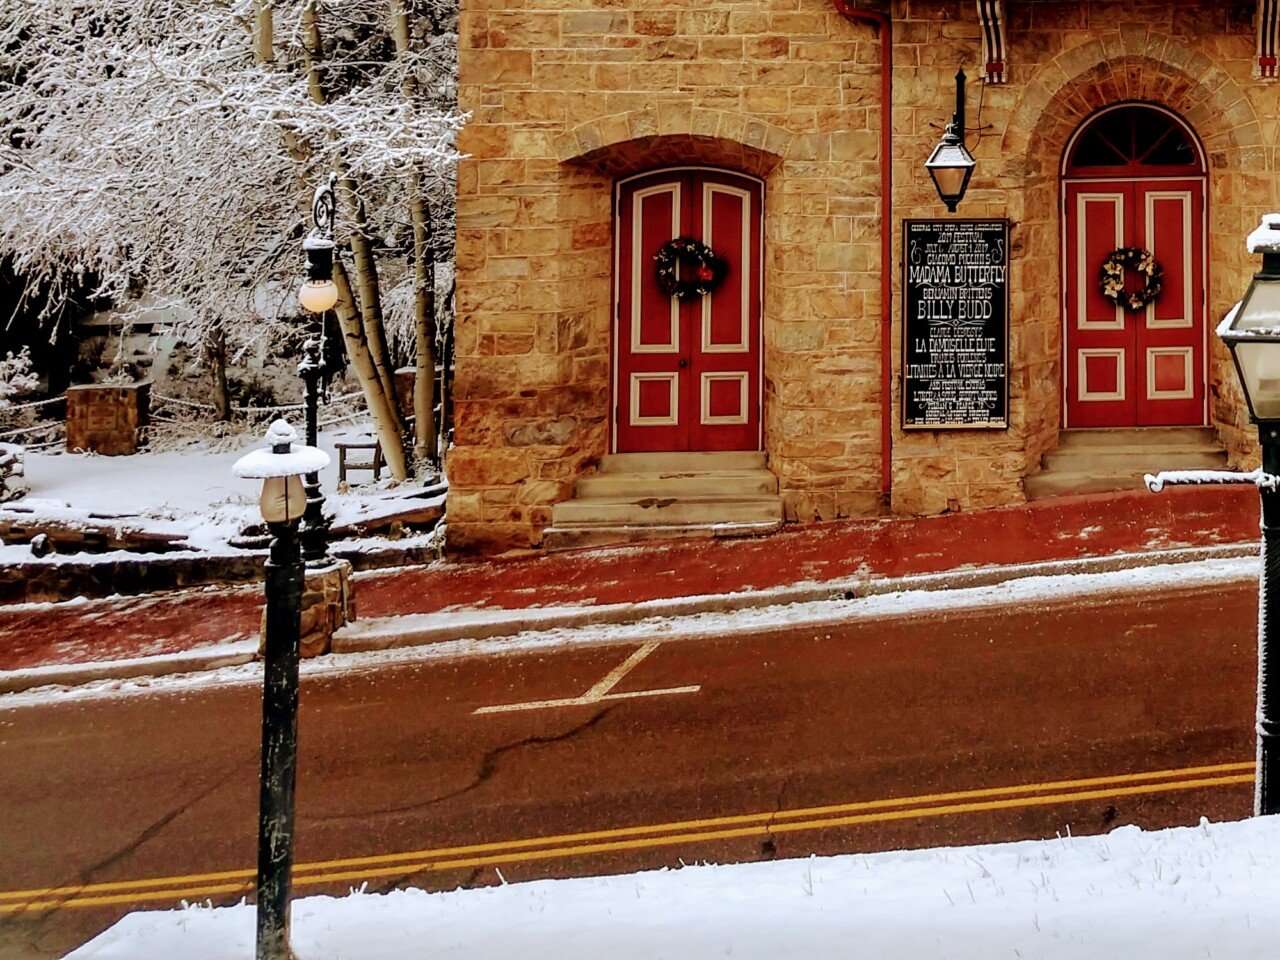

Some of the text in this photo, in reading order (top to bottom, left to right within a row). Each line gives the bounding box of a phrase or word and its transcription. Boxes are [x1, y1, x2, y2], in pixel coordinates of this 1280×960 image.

[953, 232, 986, 243] FESTIVAL
[924, 244, 938, 253] JULY
[927, 254, 956, 265] GIACOMO
[909, 265, 1006, 283] MADAMA BUTTERFLY
[923, 288, 957, 300] BENJAMIN
[917, 300, 992, 319] BILLY BUDD
[915, 338, 927, 353] LA
[929, 338, 975, 352] DAMOISELLE
[906, 364, 937, 379] LITANIES
[946, 364, 957, 378] LA
[958, 364, 983, 378] VIERGE
[984, 363, 1005, 378] NOIRE
